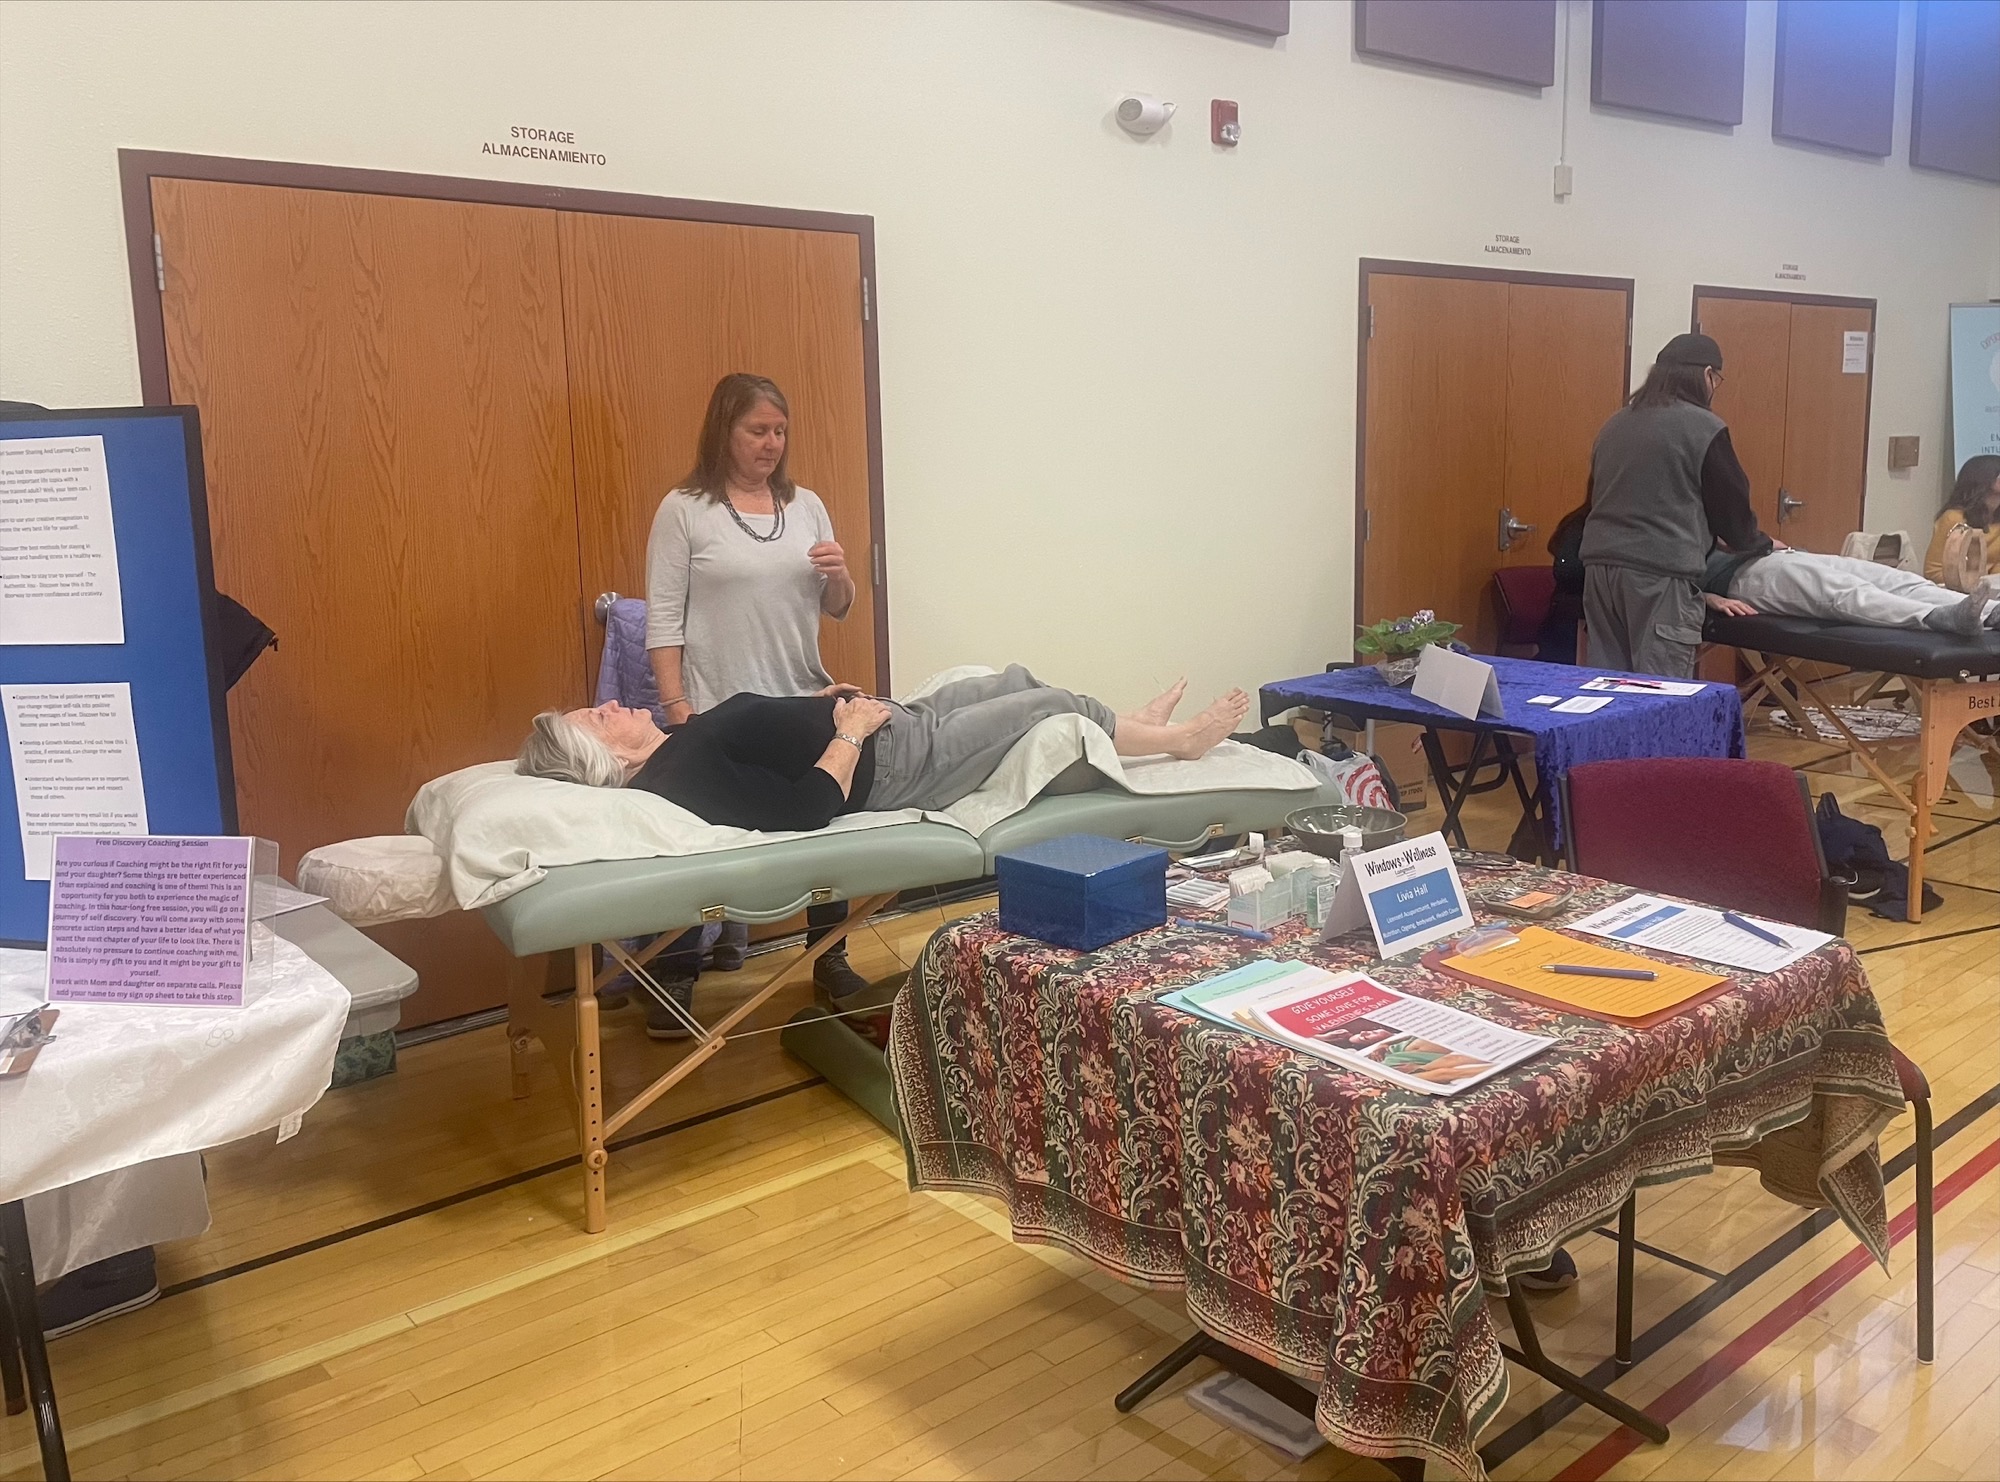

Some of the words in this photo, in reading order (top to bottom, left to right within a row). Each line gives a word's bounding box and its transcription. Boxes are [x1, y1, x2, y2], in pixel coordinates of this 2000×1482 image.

[511, 126, 574, 144] STORAGE
[482, 142, 606, 165] ALMACENAMIENTO
[1495, 234, 1520, 243] STORAGE
[1484, 245, 1531, 255] ALMACENAMIENTO
[1968, 696, 1995, 710] Best
[112, 839, 147, 848] Discovery
[147, 839, 181, 848] Coaching
[116, 861, 148, 869] Coaching
[149, 861, 169, 870] might
[195, 862, 211, 870] right
[234, 863, 247, 871] you
[1364, 857, 1402, 877] Windows
[1402, 846, 1436, 864] Wellness
[87, 871, 122, 880] daughter?
[144, 872, 165, 880] things
[203, 872, 247, 881] experienced
[76, 882, 109, 890] explained
[125, 882, 156, 891] coaching
[61, 892, 101, 901] opportunity
[156, 893, 194, 902] experience
[209, 894, 230, 903] magic
[1396, 890, 1414, 903] Livia
[1413, 883, 1428, 897] Hall
[54, 903, 86, 912] coaching.
[111, 904, 145, 913] hour-long
[162, 905, 189, 913] session,
[104, 915, 139, 923] discovery.
[107, 925, 125, 934] steps
[104, 936, 130, 945] chapter
[56, 945, 91, 954] absolutely
[176, 948, 207, 957] coaching
[76, 957, 98, 965] simply
[112, 957, 123, 966] gift
[170, 959, 190, 967] might
[219, 960, 231, 968] gift
[130, 969, 161, 978] yourself.
[123, 980, 155, 989] daughter
[167, 981, 197, 990] separate
[70, 990, 86, 998] your
[129, 991, 143, 999] sign
[217, 993, 235, 1002] step.
[1291, 1001, 1315, 1014] GIVE
[1312, 986, 1355, 1006] YOURSELF
[1305, 1009, 1334, 1024] SOME
[1330, 1001, 1356, 1014] LOVE
[1352, 995, 1374, 1005] FOR
